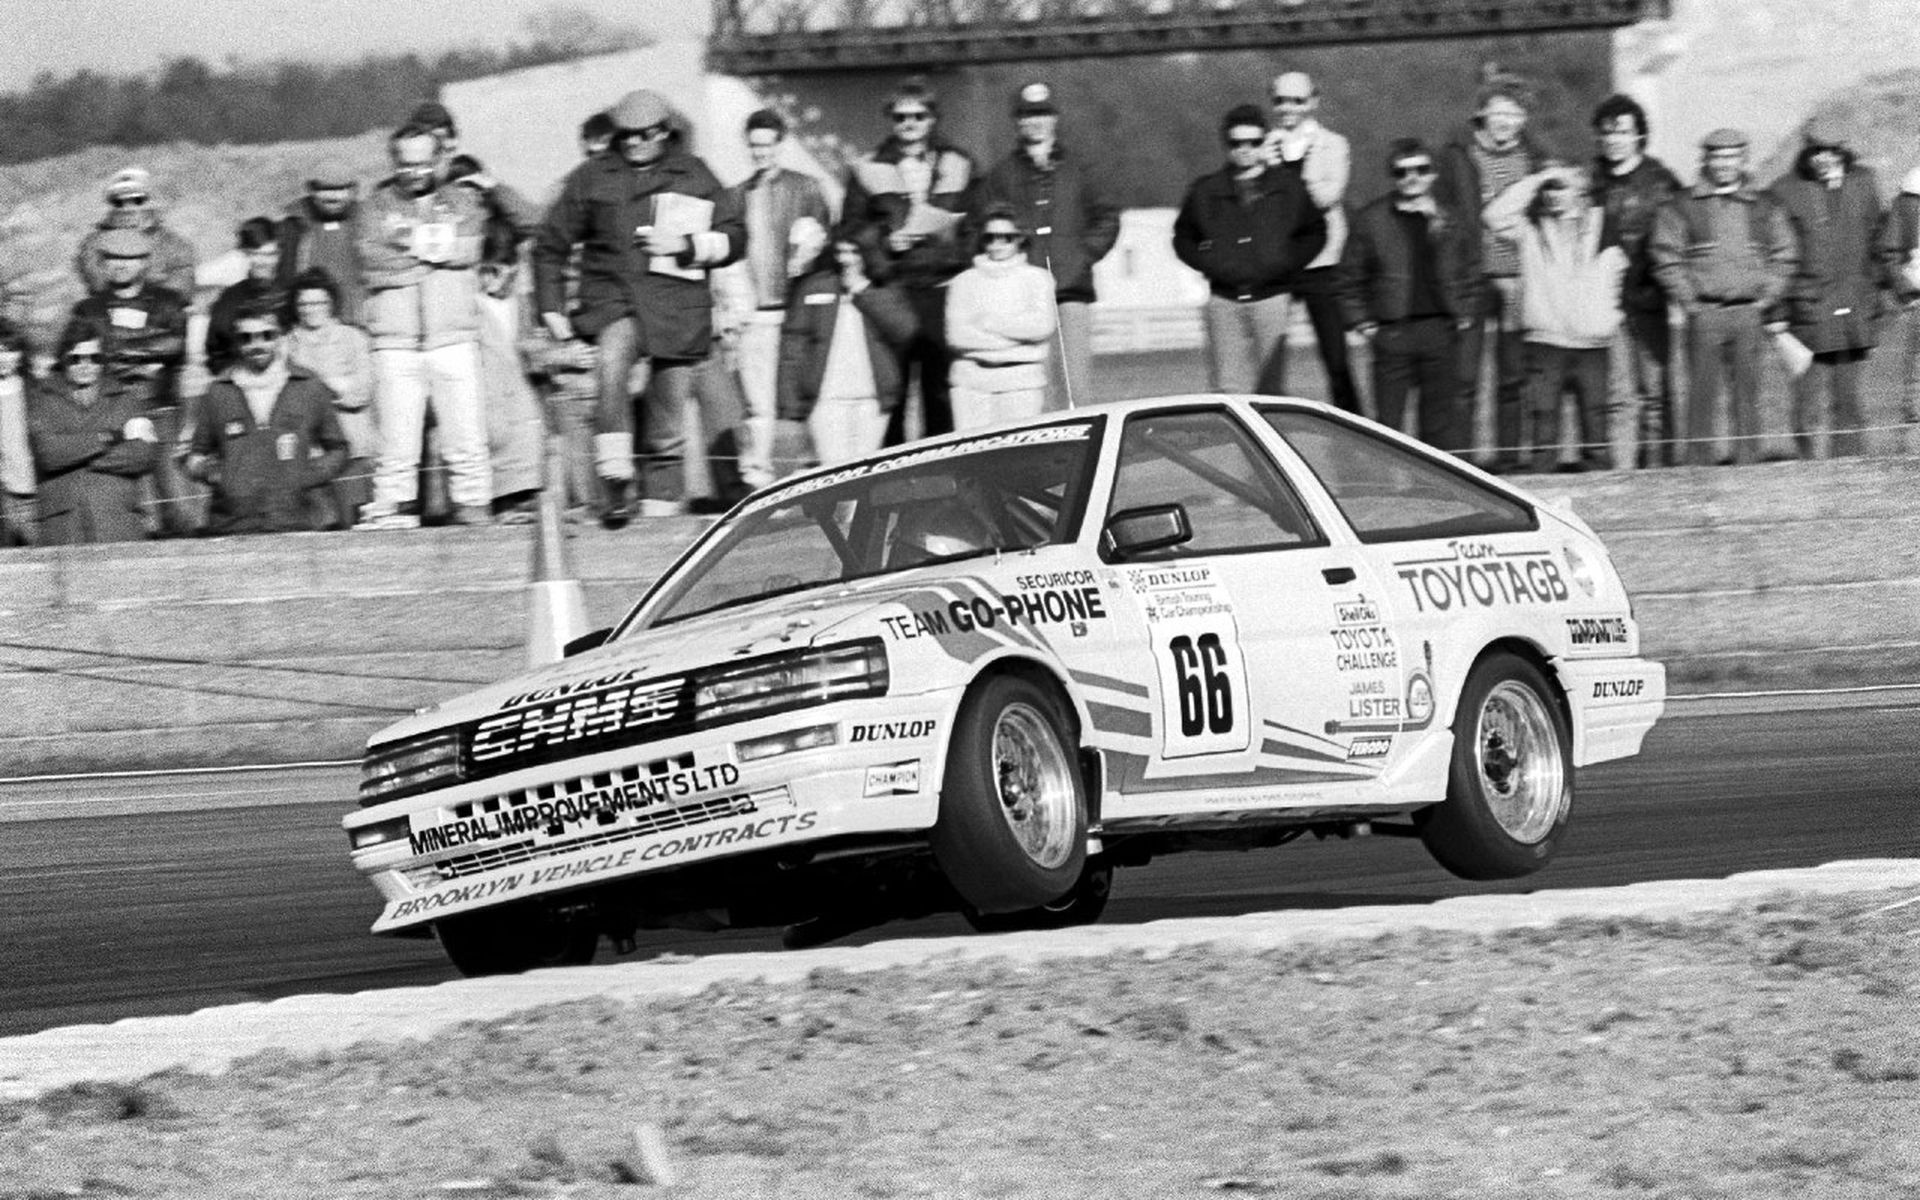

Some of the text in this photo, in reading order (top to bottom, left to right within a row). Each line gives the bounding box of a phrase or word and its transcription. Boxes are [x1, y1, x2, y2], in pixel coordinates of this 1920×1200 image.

[1448, 541, 1500, 560] Team
[1016, 569, 1096, 590] SECURICOR
[1148, 569, 1211, 586] DUNLOP
[880, 587, 1106, 640] TEAM GO-PHONE
[1330, 627, 1394, 650] TOYOTA
[1337, 651, 1398, 671] CHALLENGE
[1169, 632, 1234, 737] 66
[1350, 681, 1385, 695] JAMES
[1592, 679, 1645, 698] DUNLOP
[1350, 698, 1400, 717] LISTER
[849, 720, 936, 742] DUNLOP
[409, 763, 739, 856] MINERAL IMPROVEMENTS LTD
[391, 811, 818, 920] BROOKLYN VEHICLE CONTRACTS
